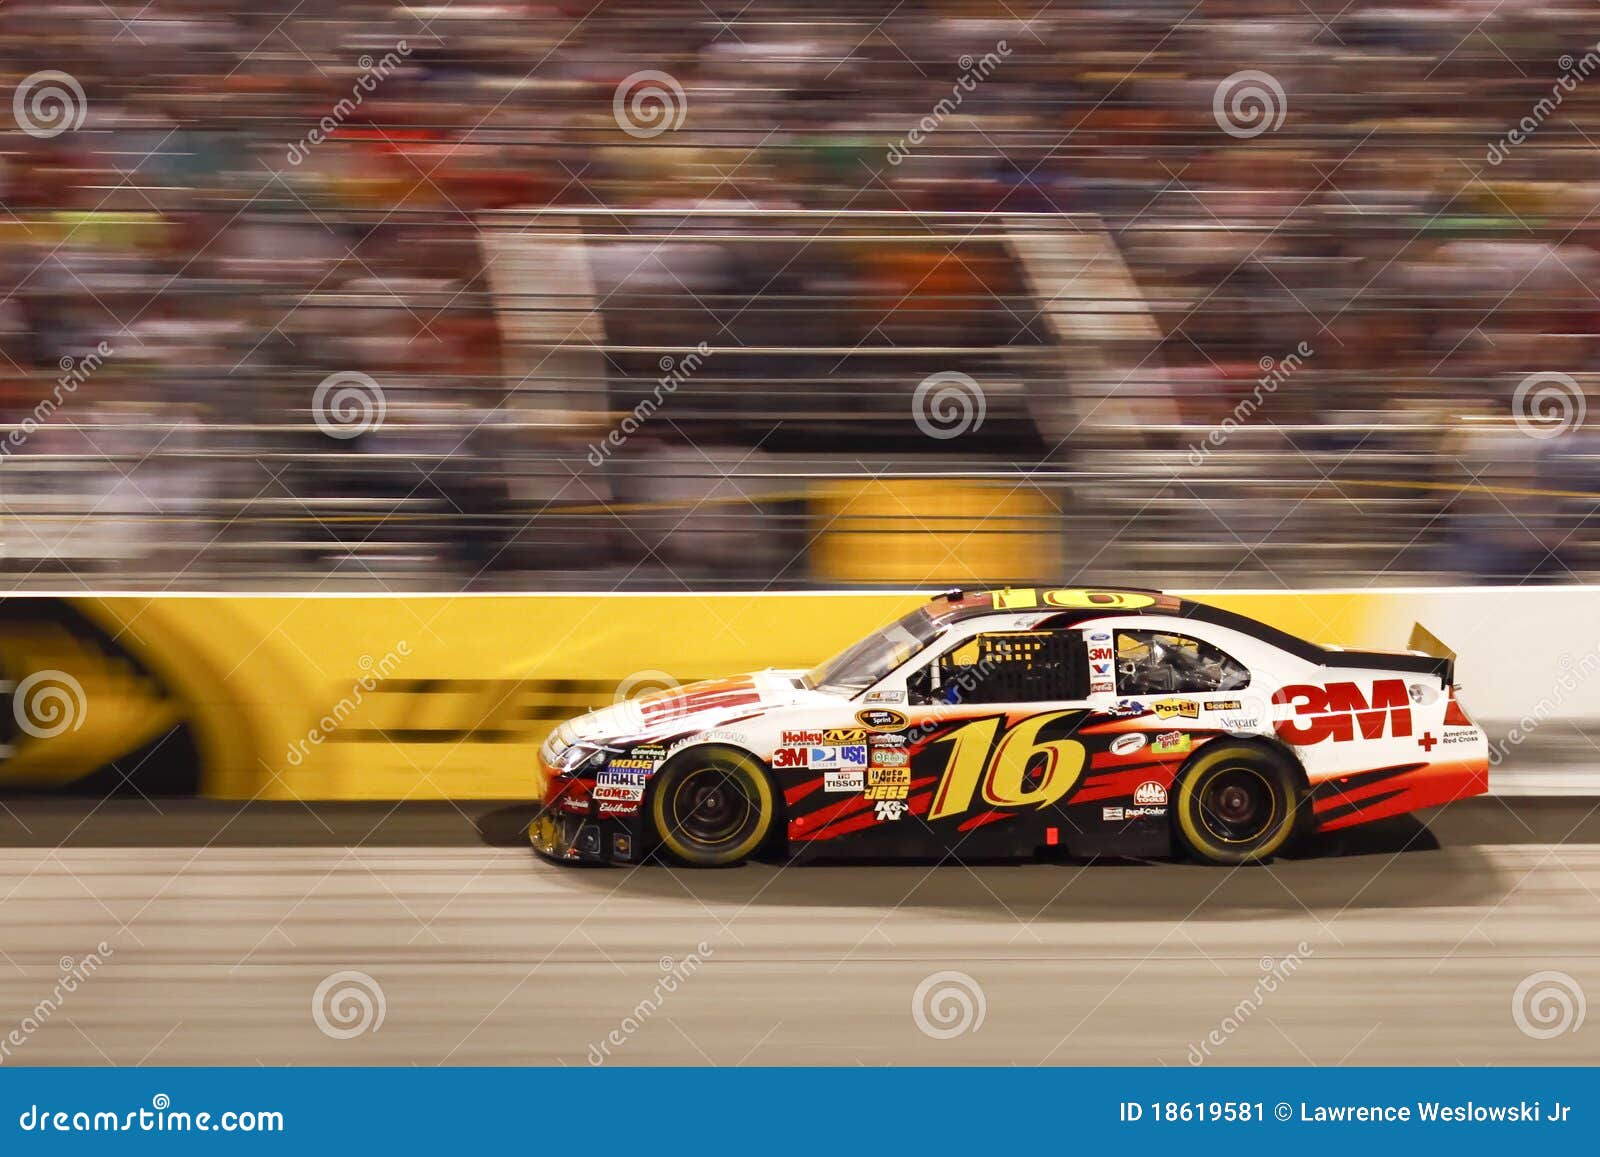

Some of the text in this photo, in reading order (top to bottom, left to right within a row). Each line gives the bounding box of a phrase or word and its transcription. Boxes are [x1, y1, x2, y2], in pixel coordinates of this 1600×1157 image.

[1089, 648, 1112, 660] 3M
[1155, 703, 1196, 712] Post-it
[1206, 702, 1239, 710] Scotch
[1271, 679, 1413, 746] 3M
[1220, 718, 1258, 728] Nexcare
[782, 731, 822, 744] Holley
[774, 747, 808, 767] 3M
[841, 745, 866, 765] USG
[608, 759, 653, 769] MOOG
[927, 709, 1086, 821] 16
[598, 773, 645, 786] MAHLE
[826, 780, 863, 788] TISSOT
[880, 775, 908, 783] Meter
[596, 788, 632, 798] COMP
[864, 786, 909, 799] JEGS
